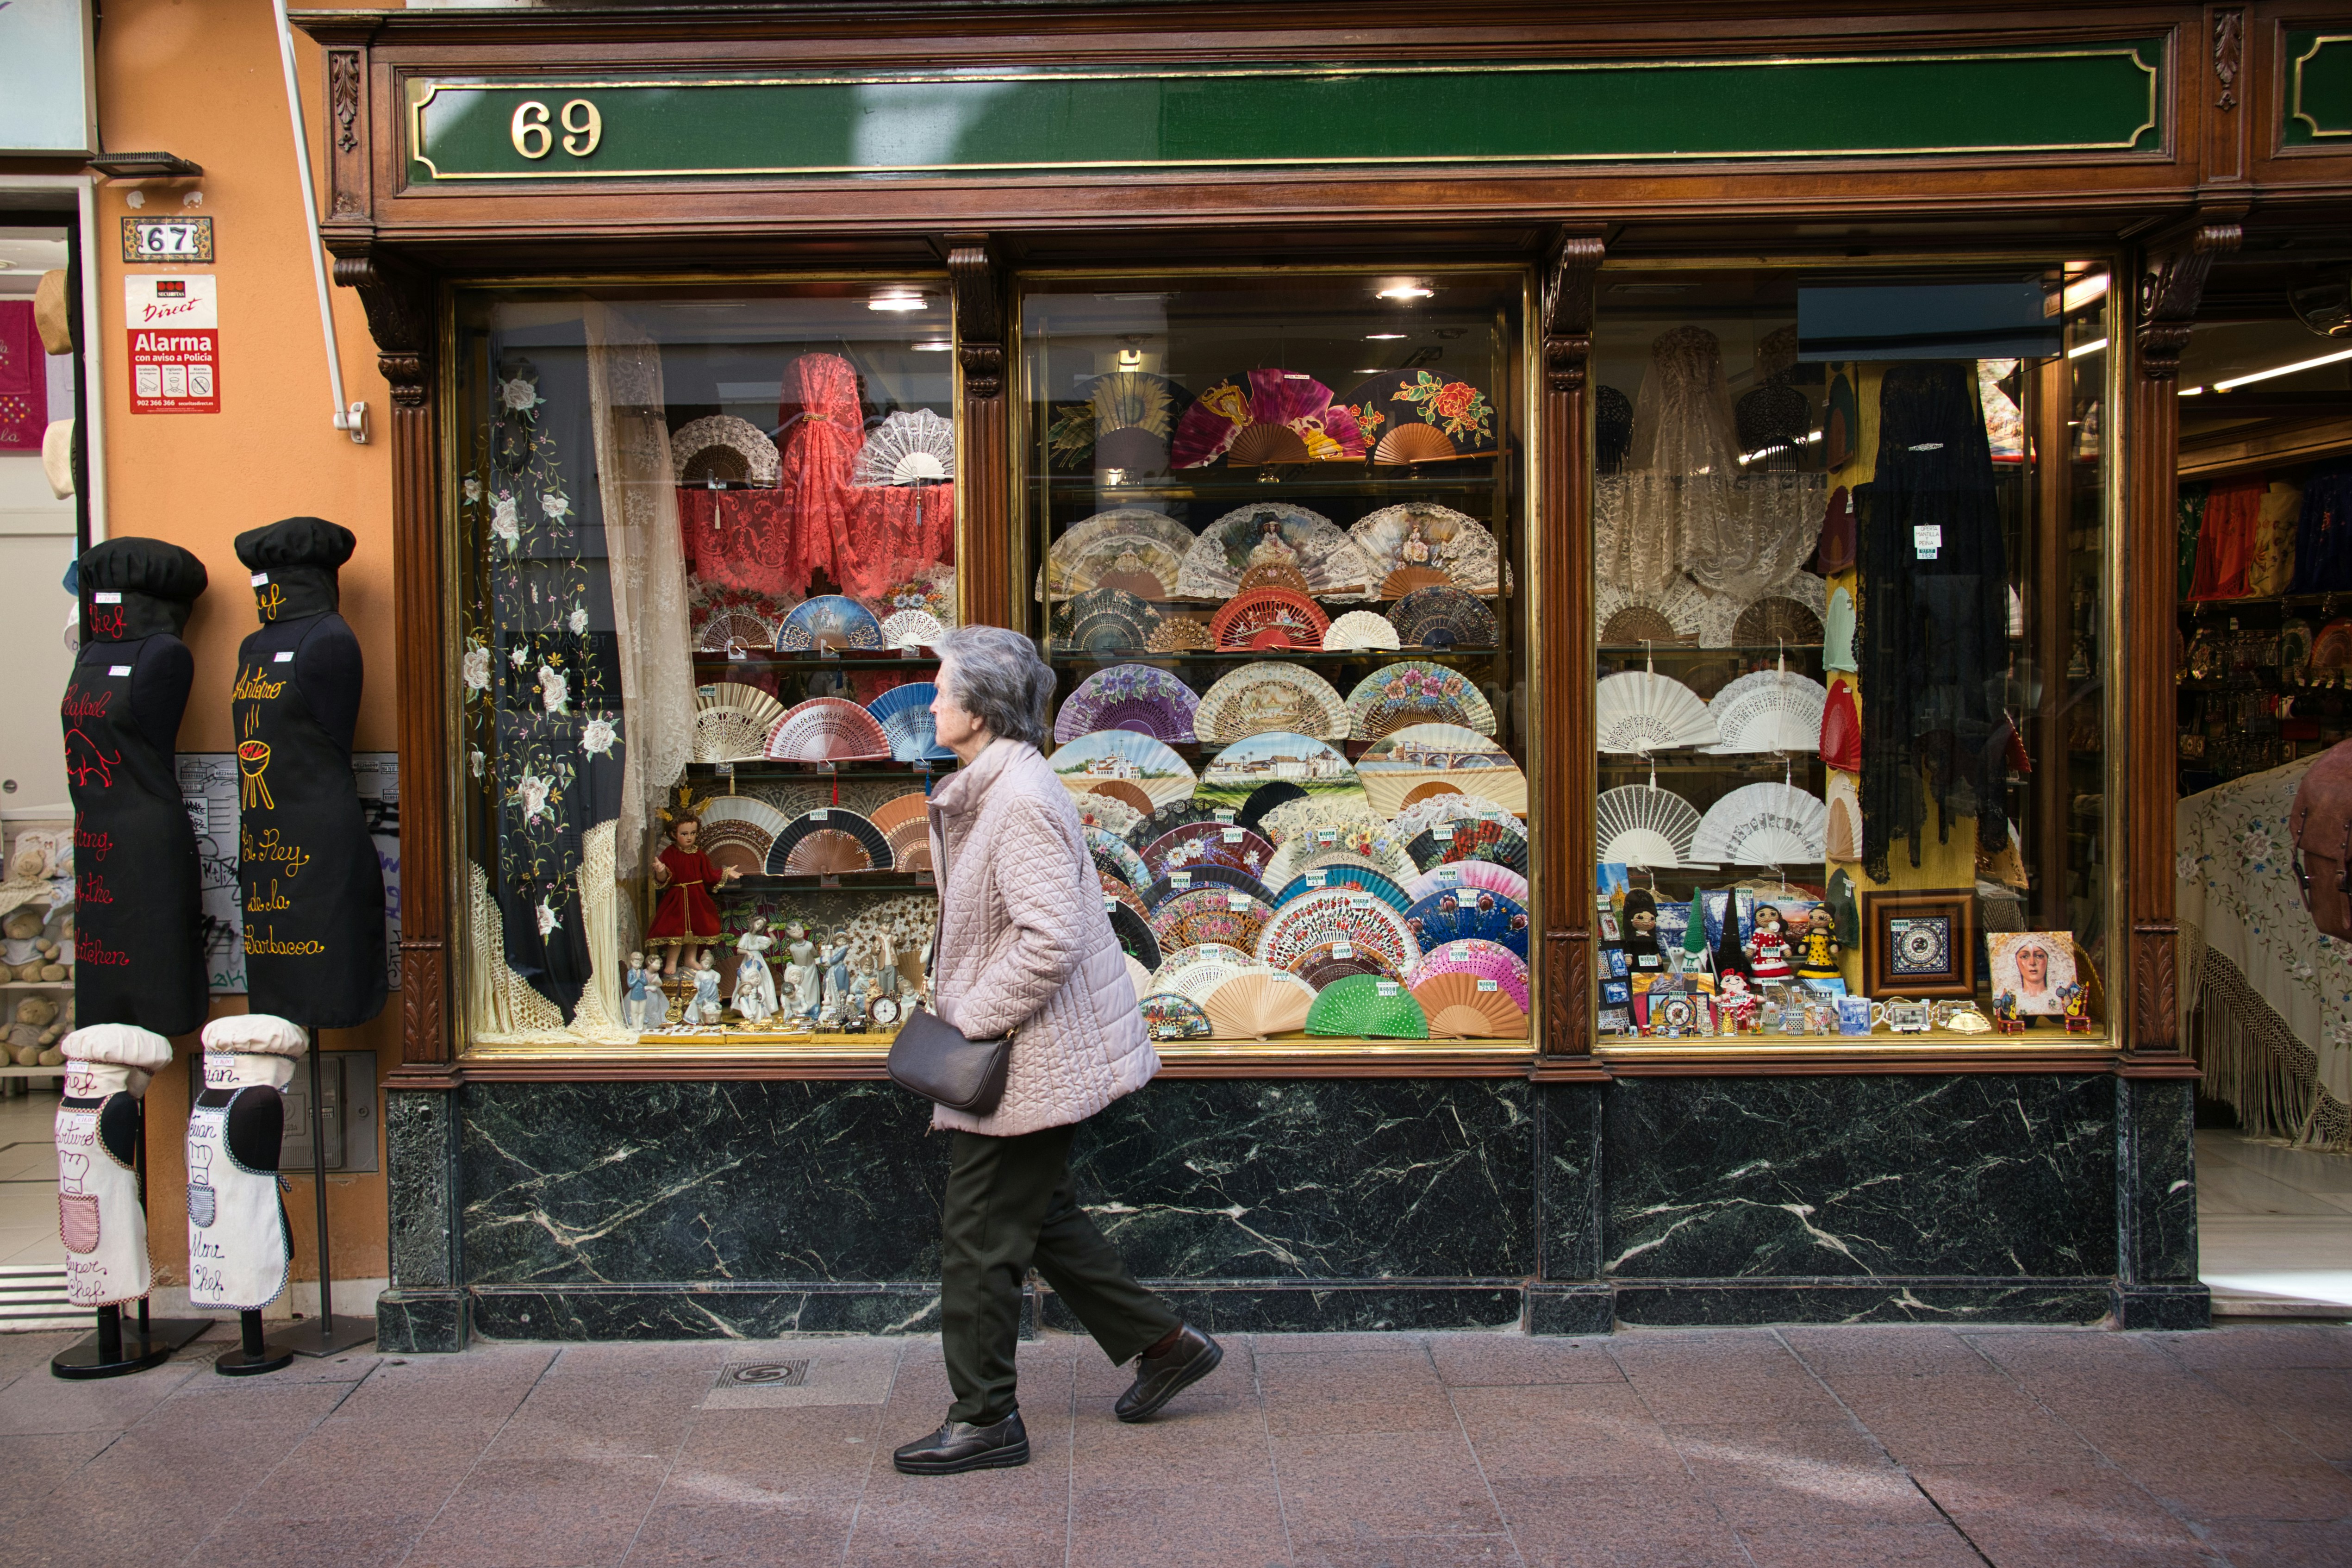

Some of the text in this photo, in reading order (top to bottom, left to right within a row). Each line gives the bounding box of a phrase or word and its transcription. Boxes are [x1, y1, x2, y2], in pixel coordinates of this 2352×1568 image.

[512, 99, 602, 158] 69
[148, 227, 187, 251] 67
[142, 298, 203, 322] Direct
[135, 332, 212, 352] Alarma
[152, 353, 175, 362] aviso
[184, 353, 212, 362] Policía
[259, 829, 310, 877] Rey
[248, 879, 290, 912] de la
[244, 925, 324, 955] Barbacoa
[204, 1063, 240, 1082] uan
[190, 1231, 225, 1258] Mini
[69, 1279, 105, 1304] Chef
[192, 1264, 224, 1301] Chef
